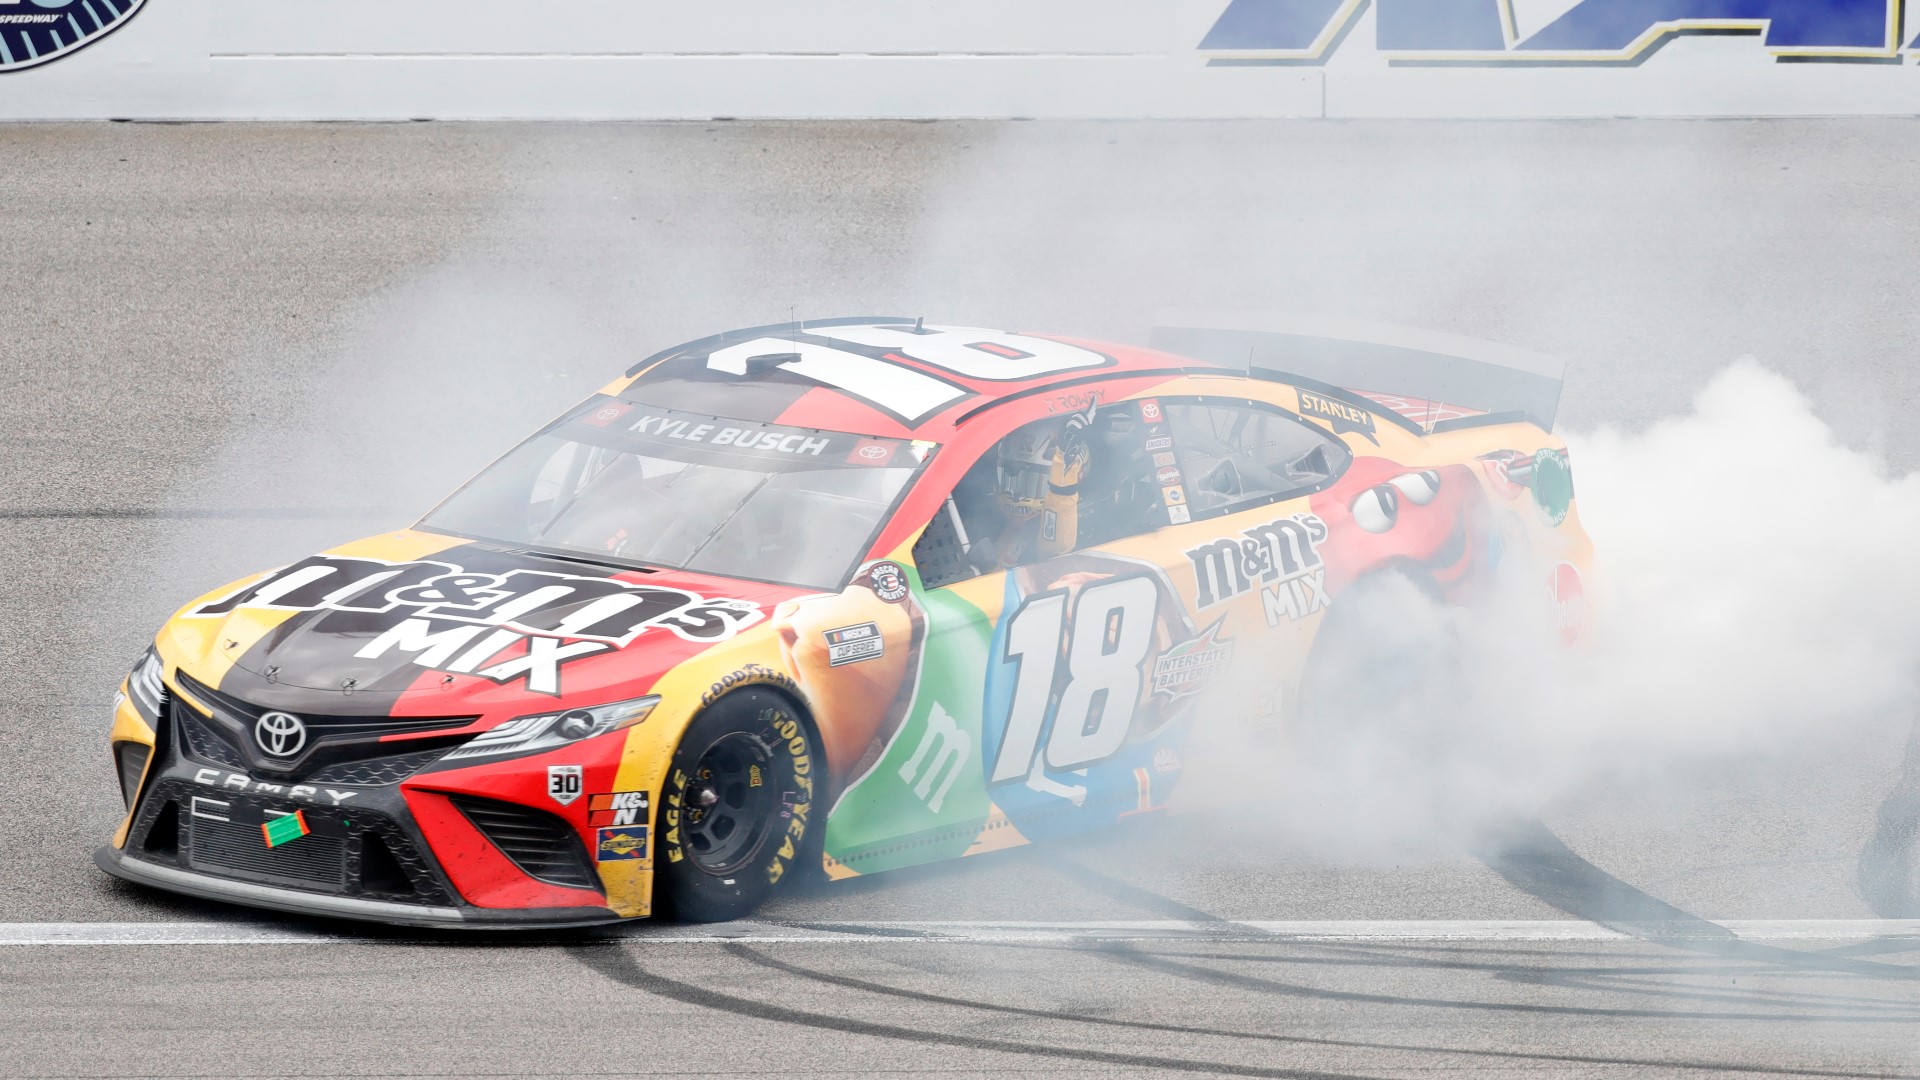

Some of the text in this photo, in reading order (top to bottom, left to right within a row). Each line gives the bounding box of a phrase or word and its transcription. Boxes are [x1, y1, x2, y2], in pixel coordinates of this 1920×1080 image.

[0, 14, 60, 24] SPEEDWAY
[1301, 393, 1368, 426] STANLEY
[628, 415, 831, 456] KYLE BUSCH
[870, 565, 899, 580] NASCAR
[877, 584, 907, 600] SALUTES
[1261, 567, 1332, 628] MIX
[354, 617, 614, 692] MIX
[837, 641, 876, 657] CUP SERIES
[1158, 647, 1228, 673] INTERSTATE
[991, 576, 1158, 784] 18
[1159, 662, 1225, 688] BATTERIES
[194, 768, 358, 806] CAMRY
[551, 773, 579, 793] 30
[767, 709, 813, 885] GOODYEAR
[666, 768, 688, 863] EAGLE
